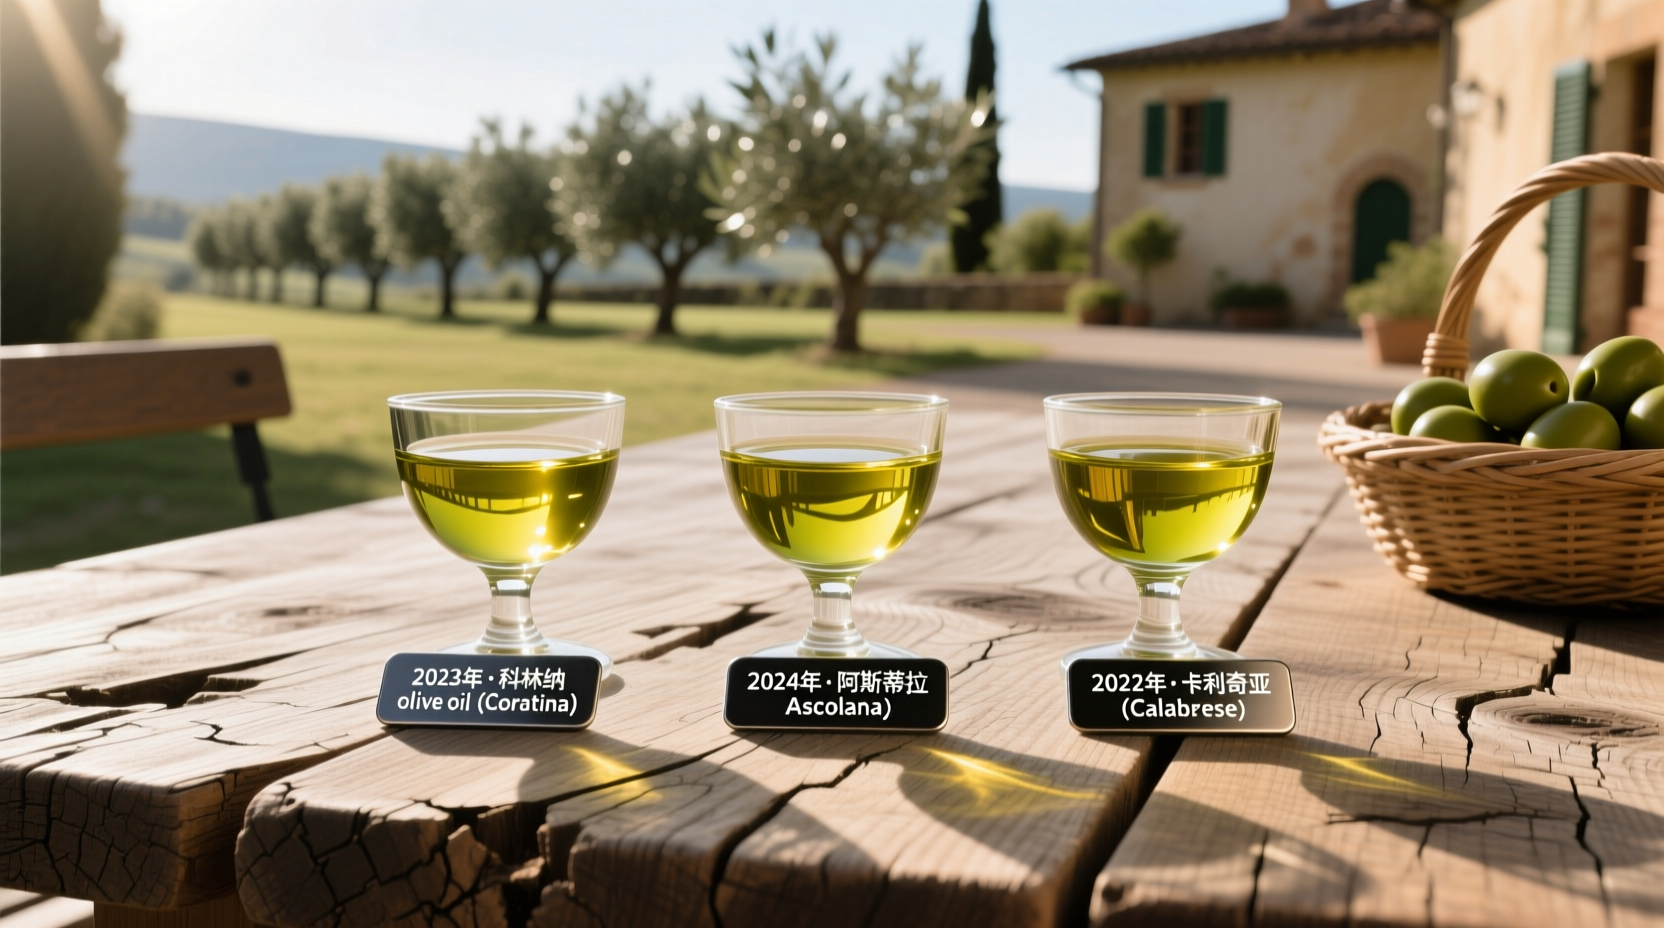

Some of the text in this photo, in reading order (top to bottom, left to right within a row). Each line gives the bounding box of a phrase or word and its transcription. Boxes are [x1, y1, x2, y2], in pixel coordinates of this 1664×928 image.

[397, 691, 578, 717] olive oil (Coratina)
[785, 696, 892, 721] Ascolana)
[1121, 697, 1246, 721] (Calabrese)
